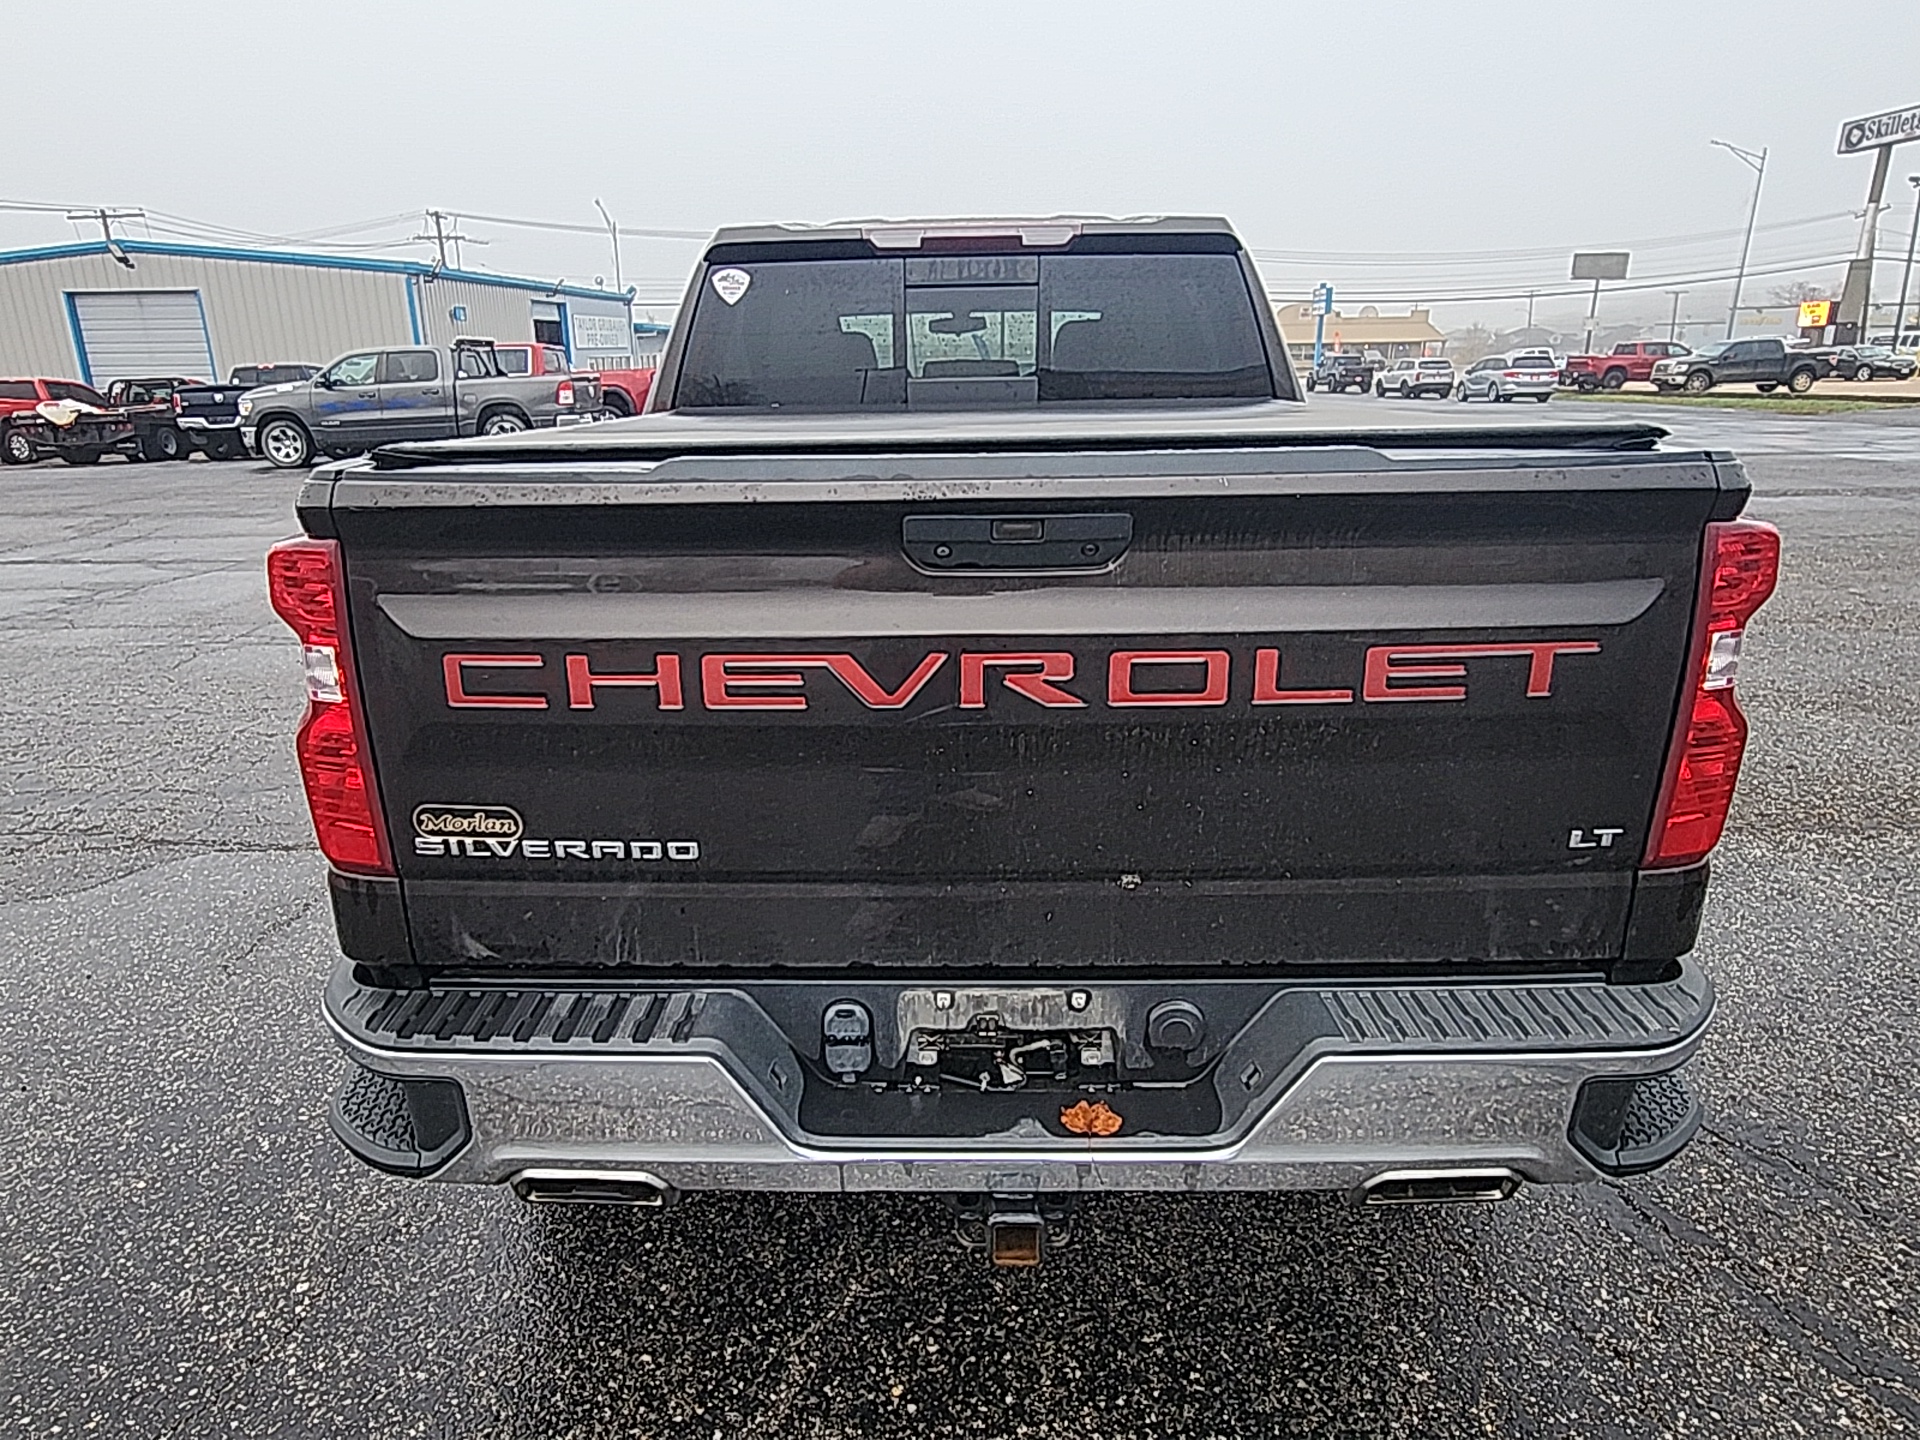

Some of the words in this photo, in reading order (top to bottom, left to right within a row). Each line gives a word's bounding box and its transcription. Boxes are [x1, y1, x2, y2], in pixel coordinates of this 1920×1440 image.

[442, 640, 1601, 711] CHEVROLET
[420, 812, 516, 834] Morlan
[414, 837, 700, 860] SILVERADO
[1569, 828, 1624, 848] LT
